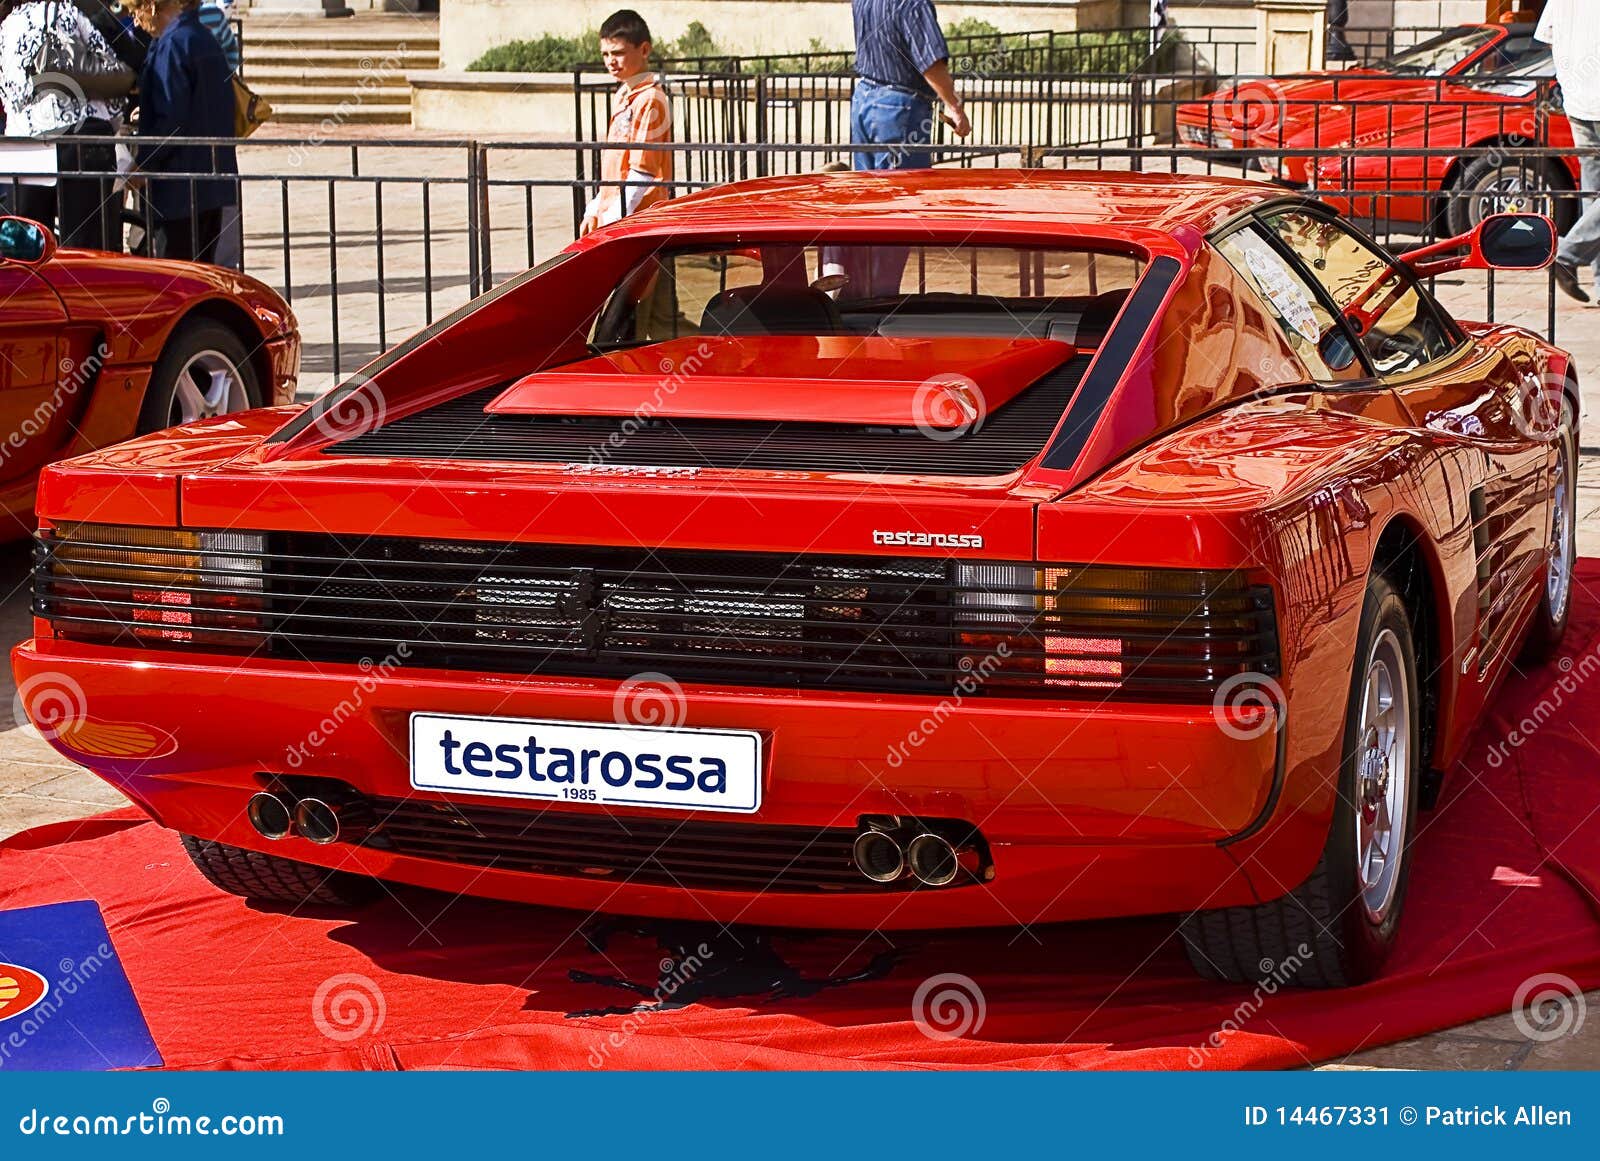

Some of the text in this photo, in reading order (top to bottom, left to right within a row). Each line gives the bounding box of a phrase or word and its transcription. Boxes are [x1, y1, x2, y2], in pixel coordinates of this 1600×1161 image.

[872, 529, 982, 548] testarossa
[439, 729, 727, 794] testarossa
[562, 787, 598, 802] 1985
